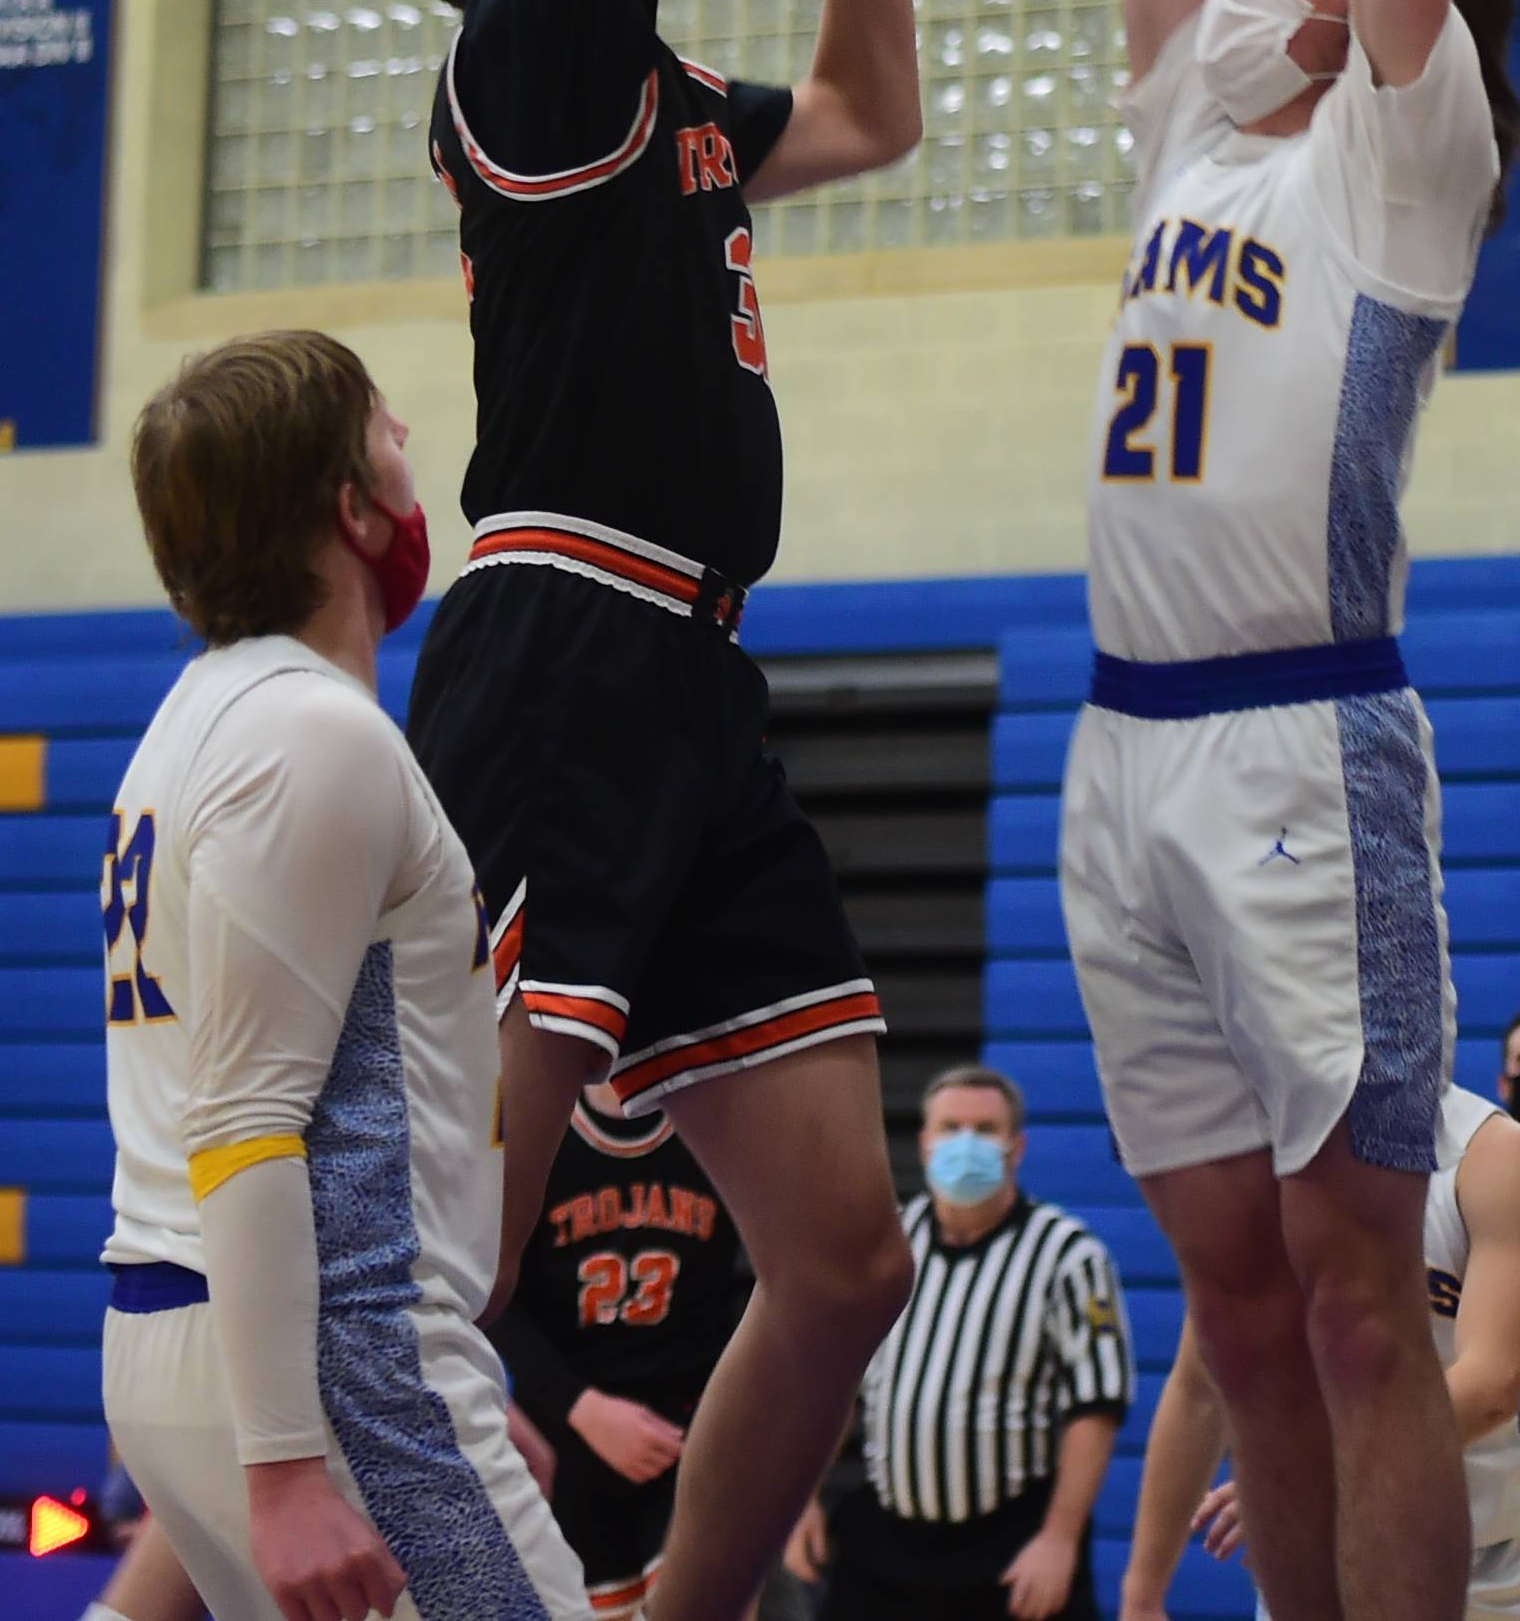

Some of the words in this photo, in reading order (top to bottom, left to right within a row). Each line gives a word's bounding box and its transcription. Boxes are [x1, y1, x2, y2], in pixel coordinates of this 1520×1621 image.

[675, 122, 739, 196] TR
[1122, 216, 1287, 331] AMS
[1101, 341, 1213, 484] 21
[548, 1183, 718, 1248] TROJANS
[577, 1250, 682, 1327] 23
